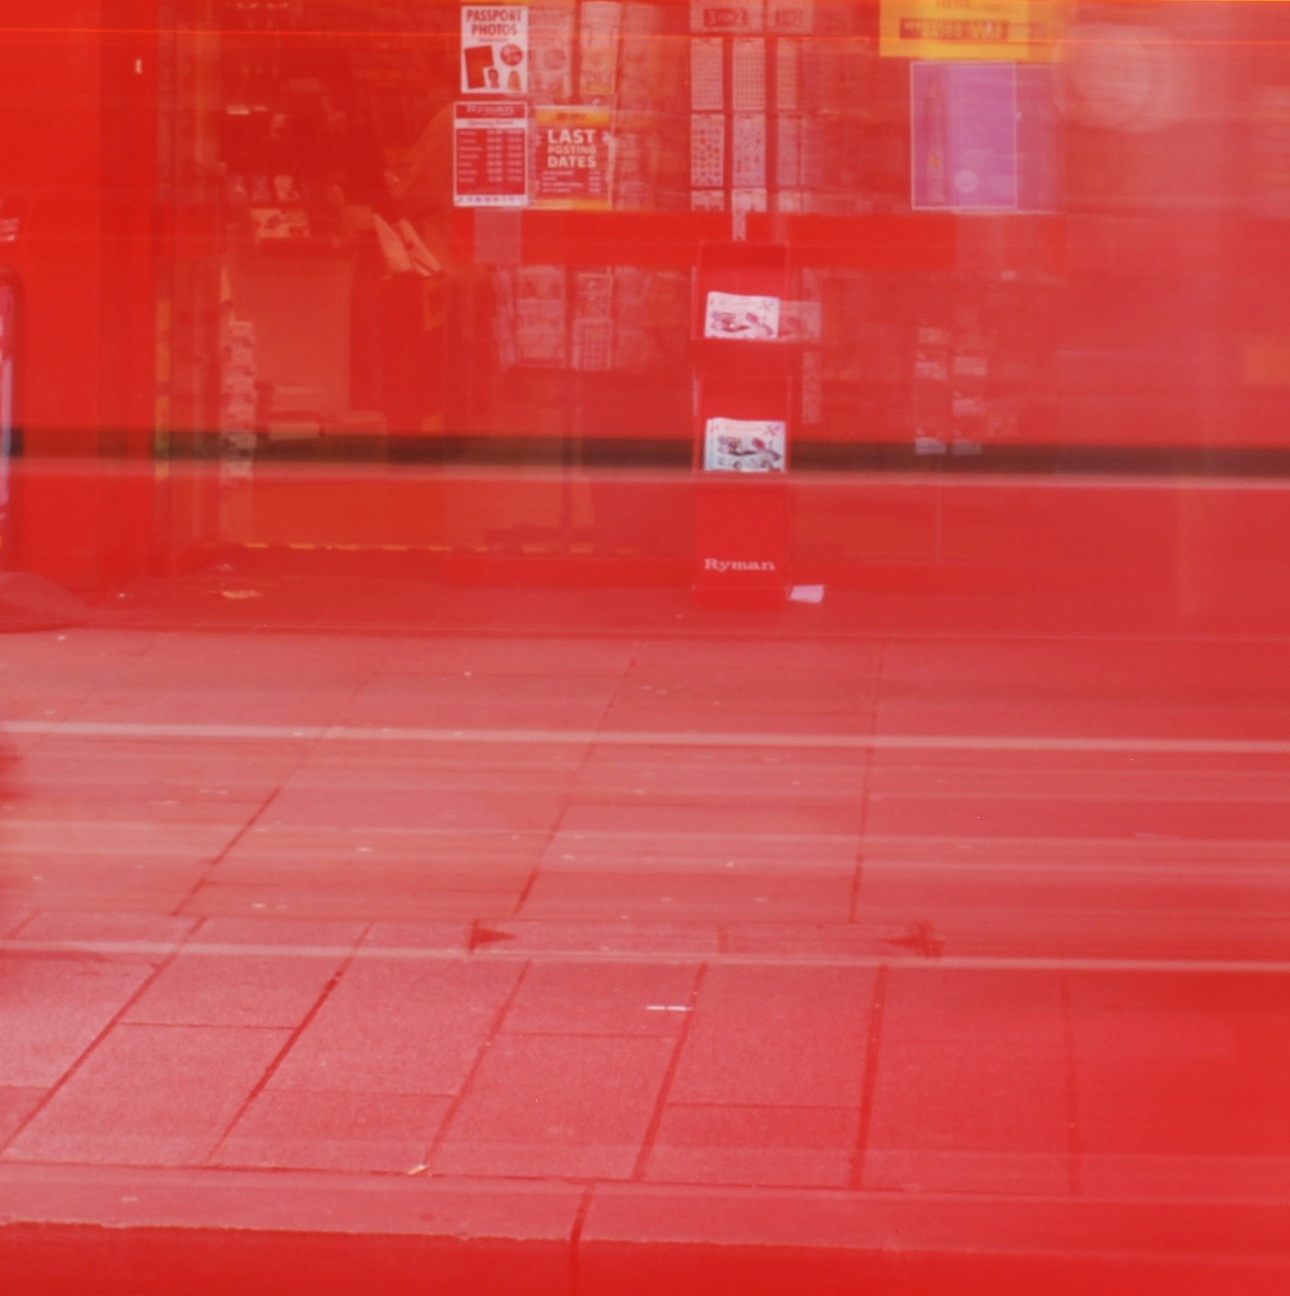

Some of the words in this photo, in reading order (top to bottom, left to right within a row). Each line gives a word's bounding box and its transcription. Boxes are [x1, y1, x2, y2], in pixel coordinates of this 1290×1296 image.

[466, 9, 522, 22] PASSPORT
[471, 23, 518, 37] PHOTOS
[547, 128, 596, 144] LAST
[547, 155, 597, 168] DATES
[704, 558, 776, 572] Ryman
